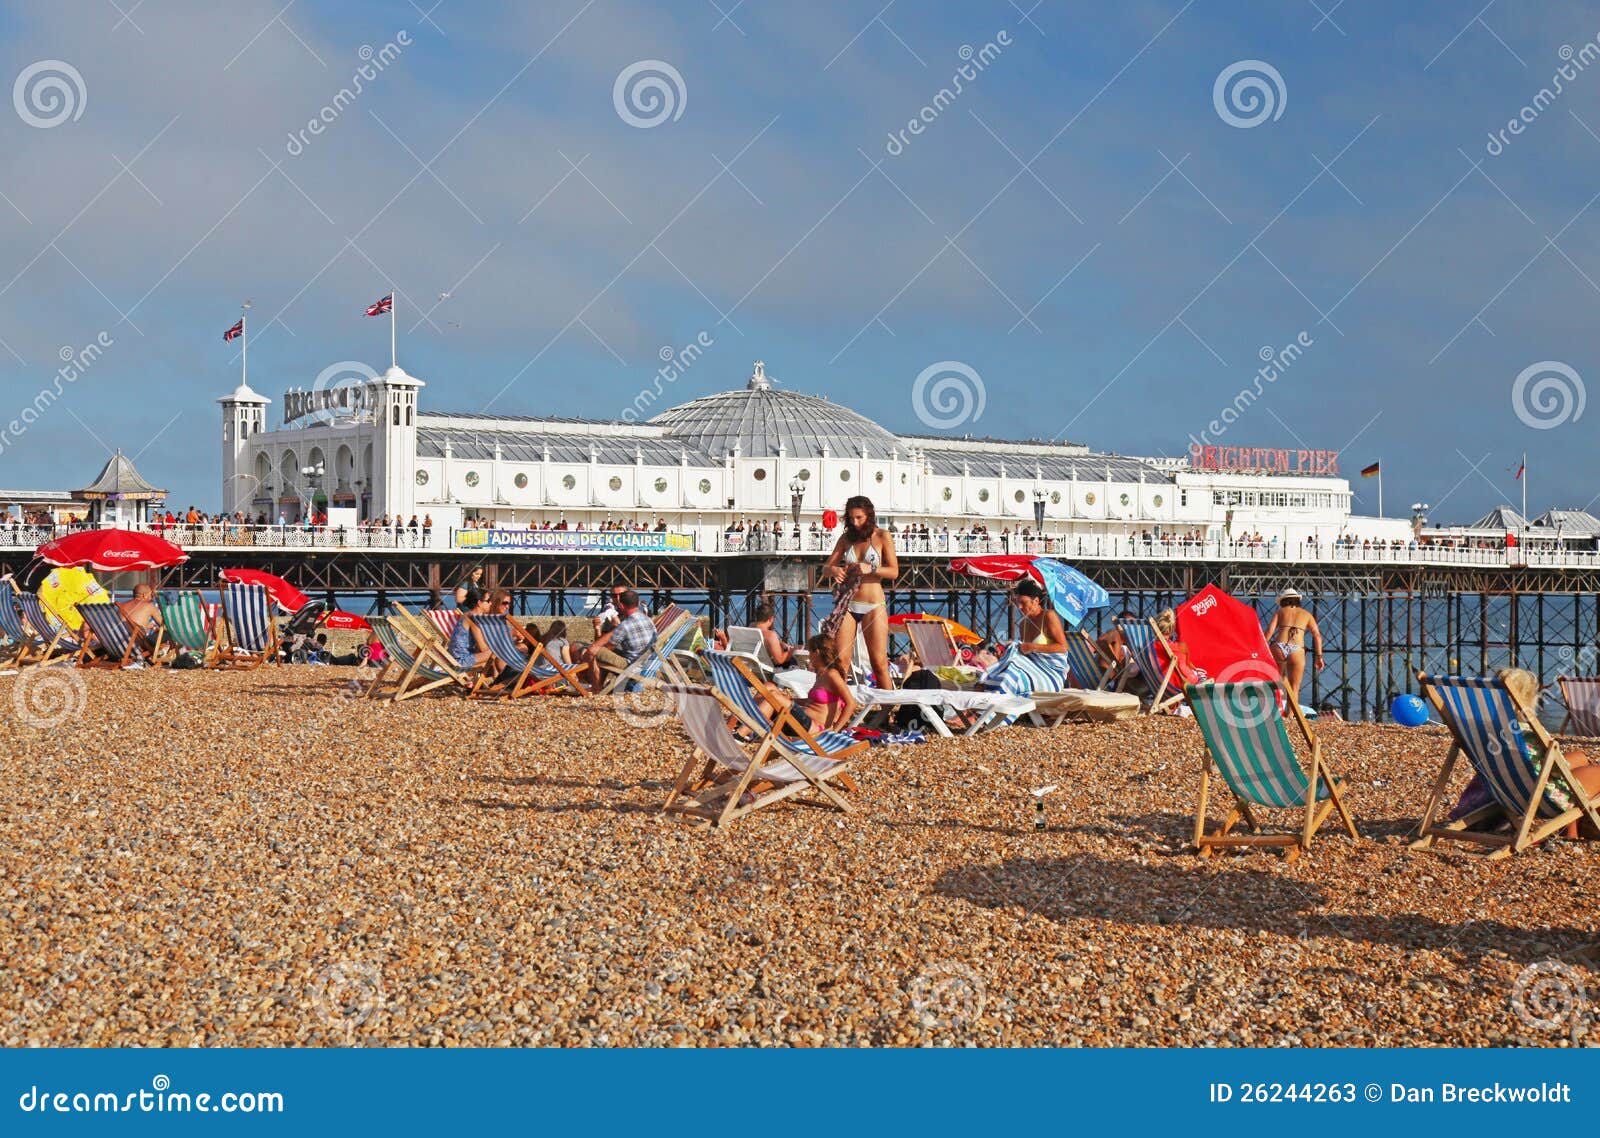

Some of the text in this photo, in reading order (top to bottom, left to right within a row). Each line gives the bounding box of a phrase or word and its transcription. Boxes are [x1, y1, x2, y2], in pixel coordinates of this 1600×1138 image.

[1191, 445, 1340, 474] BRIGHTON PIER
[491, 532, 564, 546] ADMISSION
[567, 534, 577, 545] &
[580, 533, 663, 547] DECKCHAIRS!
